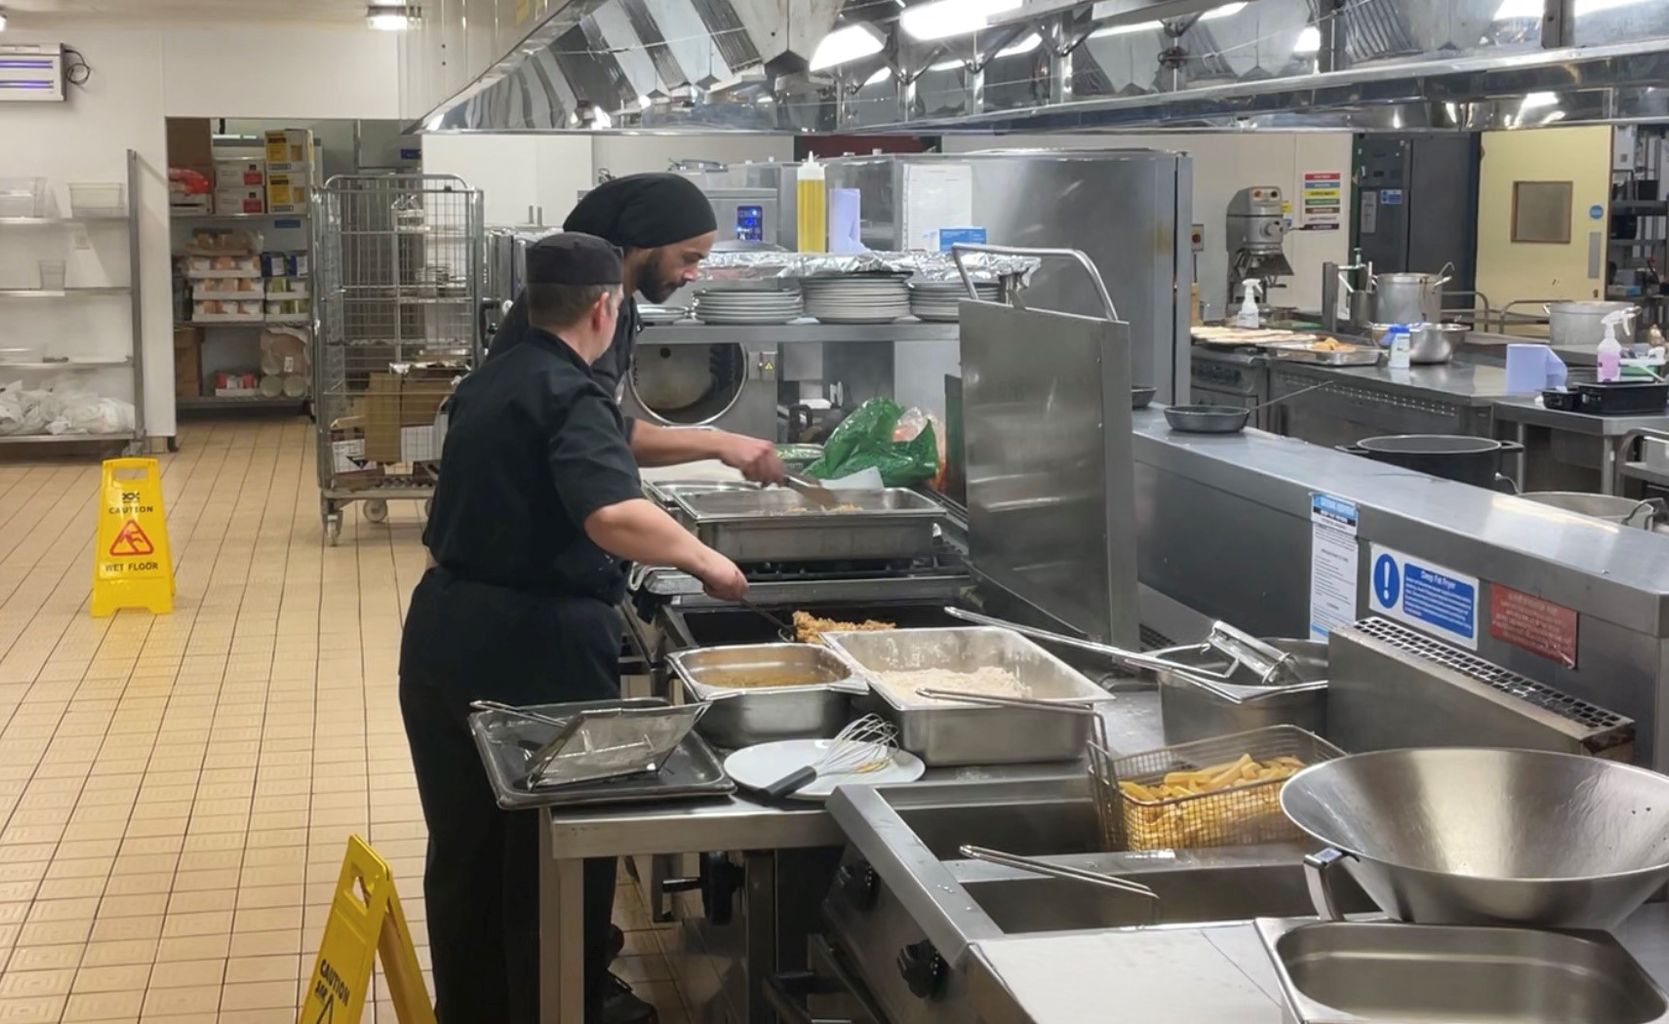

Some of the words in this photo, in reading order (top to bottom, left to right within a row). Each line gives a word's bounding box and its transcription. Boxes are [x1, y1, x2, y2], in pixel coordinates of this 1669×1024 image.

[109, 506, 153, 514] CAUTION
[105, 564, 124, 572] WET
[128, 562, 158, 571] FLOOR
[320, 958, 350, 1006] CAUTION
